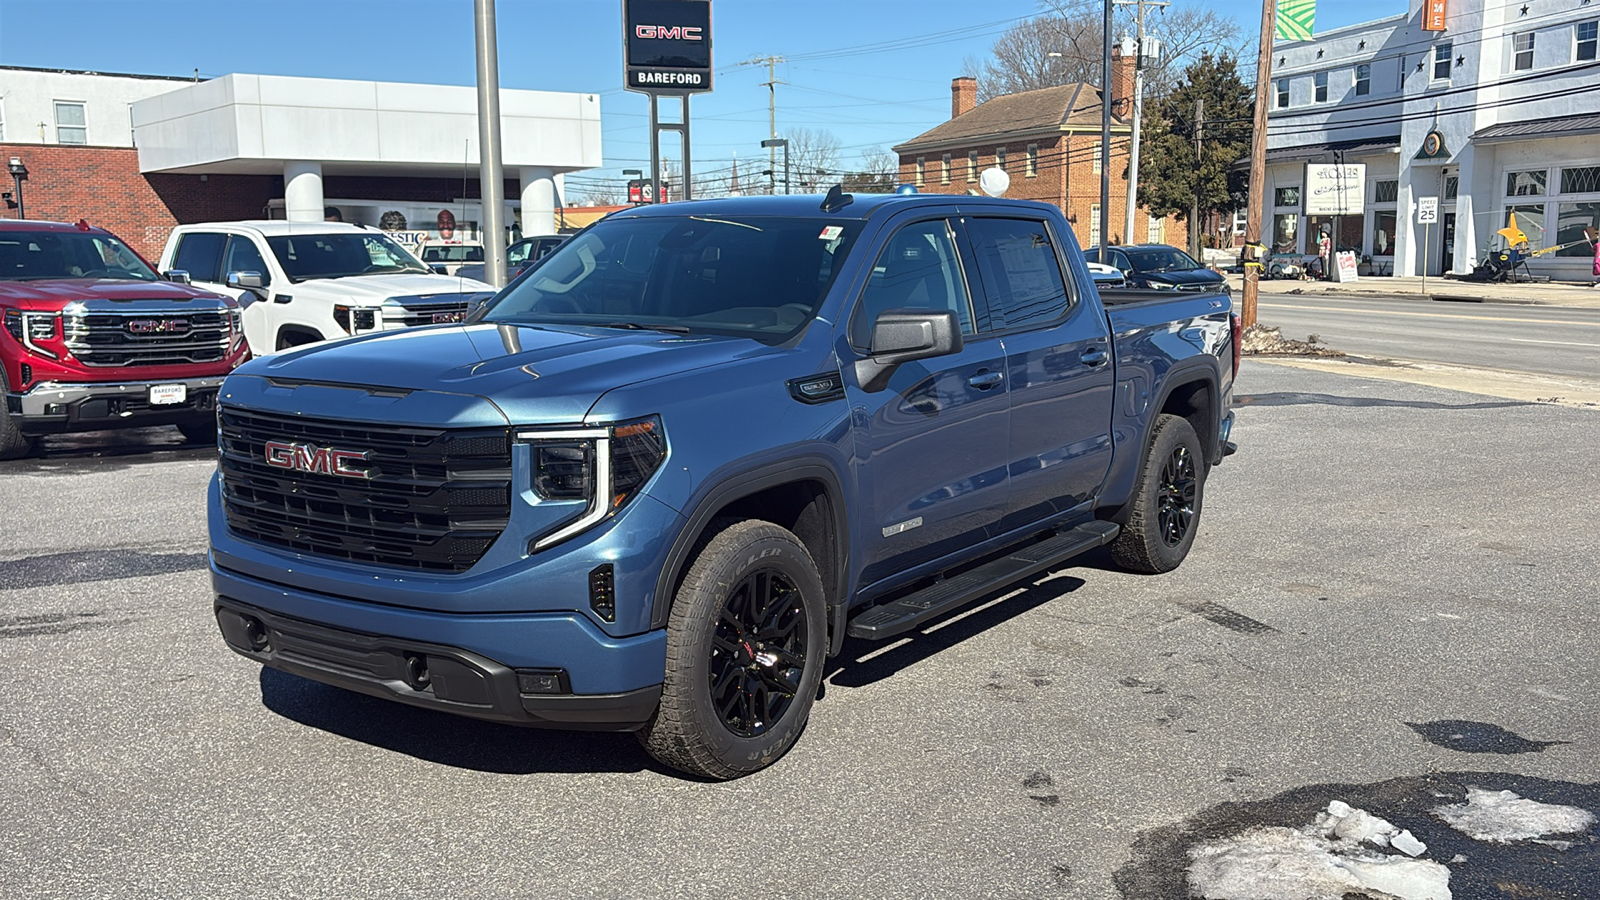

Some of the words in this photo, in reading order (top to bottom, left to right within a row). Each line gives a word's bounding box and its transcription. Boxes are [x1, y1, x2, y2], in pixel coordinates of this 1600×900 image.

[636, 25, 702, 40] GMC
[638, 72, 702, 84] BAREFORD
[1420, 210, 1435, 220] 25
[129, 320, 188, 332] GMC
[265, 441, 372, 479] GMC
